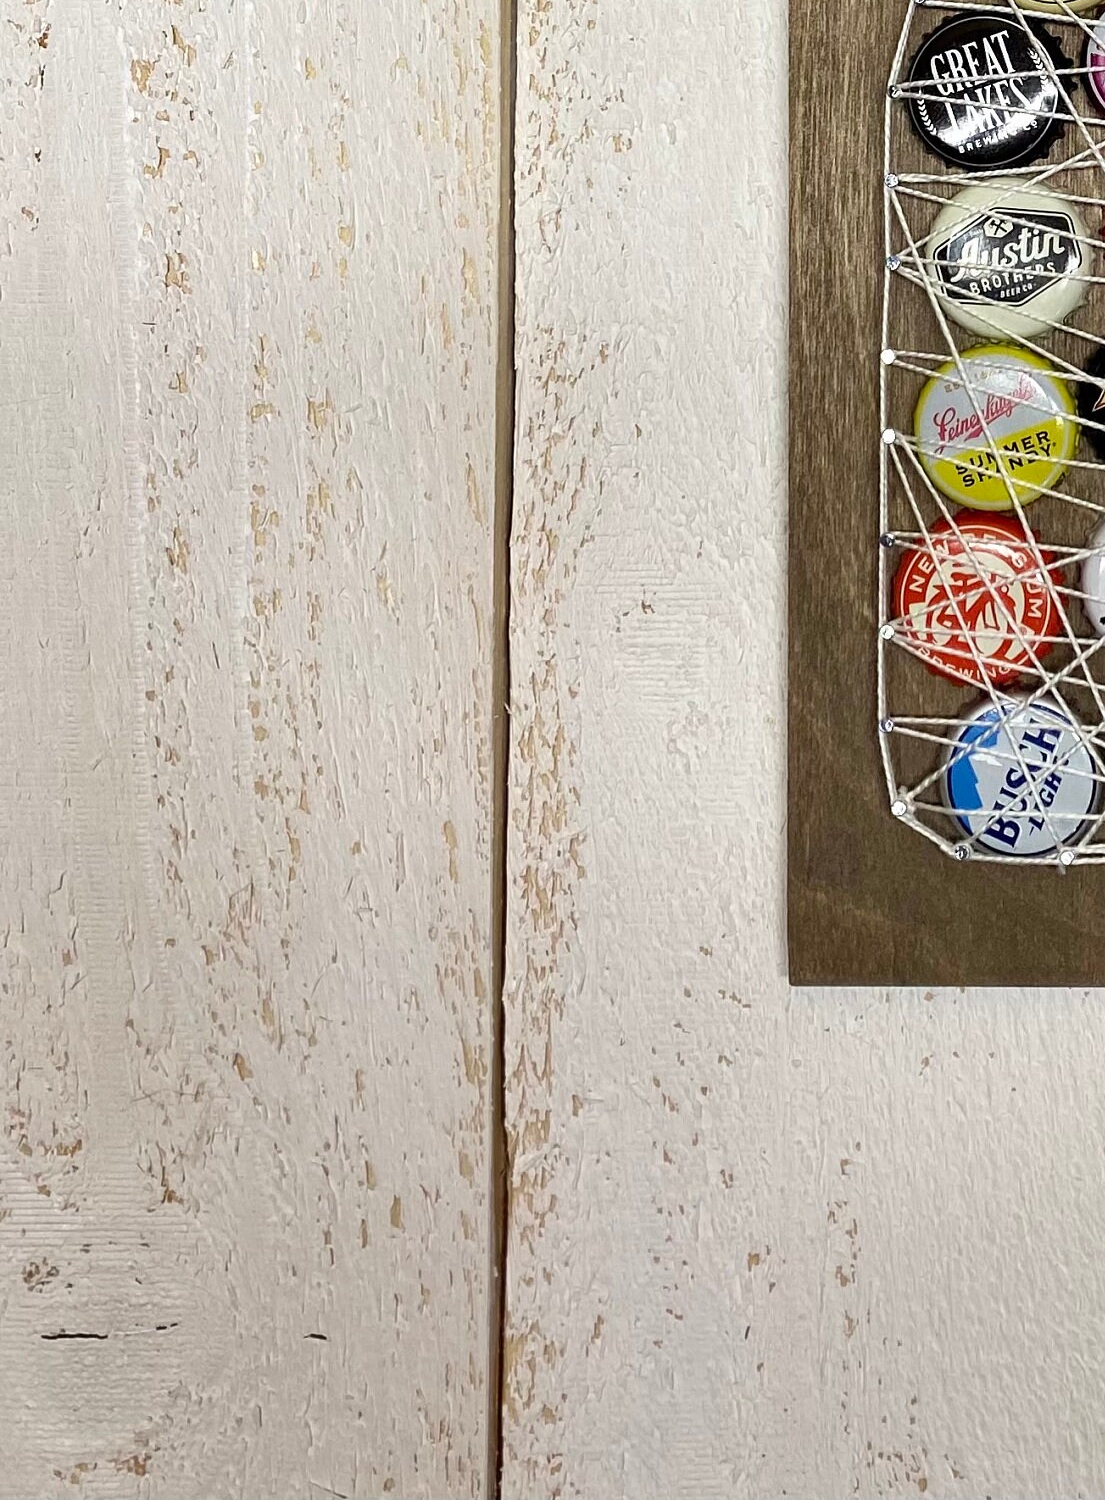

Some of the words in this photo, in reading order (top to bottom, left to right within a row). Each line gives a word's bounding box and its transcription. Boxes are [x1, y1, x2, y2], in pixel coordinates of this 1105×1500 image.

[930, 30, 1016, 96] GREAT
[944, 77, 1037, 134] LAKES
[950, 227, 1066, 283] Austin
[1000, 286, 1021, 299] BEER
[962, 443, 1051, 487] SHNDY
[909, 540, 950, 592] NEW
